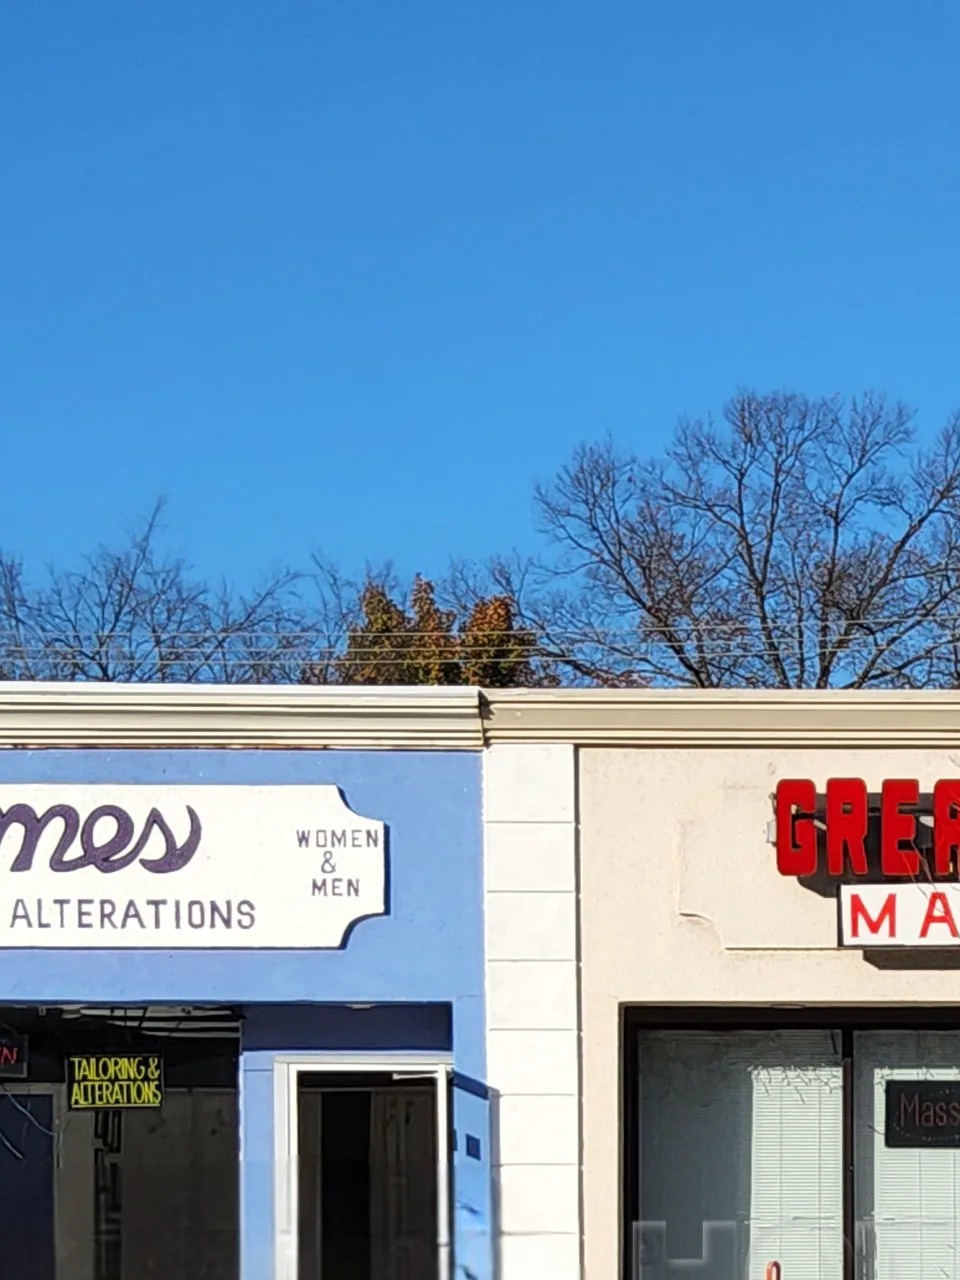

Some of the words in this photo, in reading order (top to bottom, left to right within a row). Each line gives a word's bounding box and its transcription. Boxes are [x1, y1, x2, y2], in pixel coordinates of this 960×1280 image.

[297, 829, 379, 848] WOMEN
[320, 850, 336, 874] &
[311, 877, 360, 897] MEN
[10, 897, 256, 930] ALTERATIONS
[70, 1057, 145, 1081] TAILORING
[147, 1057, 160, 1079] &
[71, 1080, 162, 1105] ALTERATIONS
